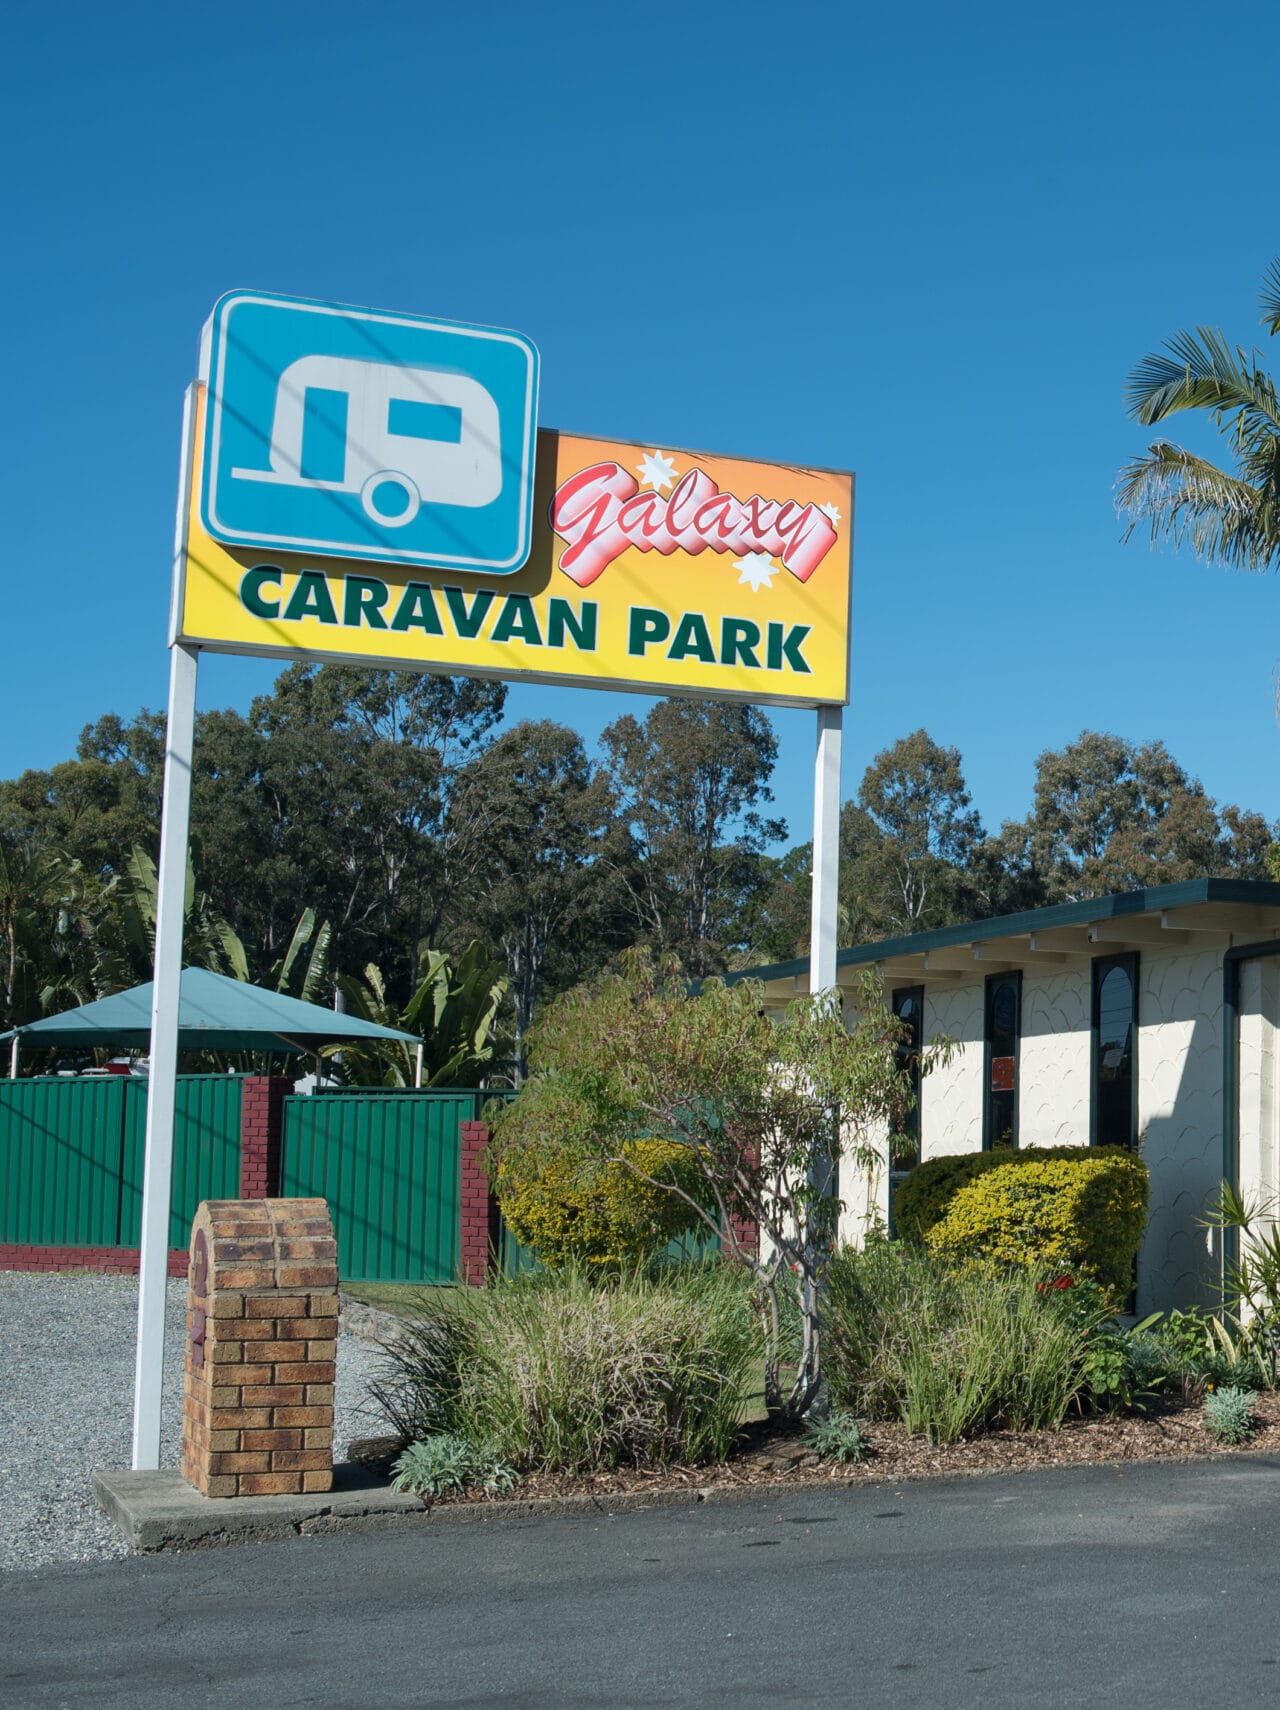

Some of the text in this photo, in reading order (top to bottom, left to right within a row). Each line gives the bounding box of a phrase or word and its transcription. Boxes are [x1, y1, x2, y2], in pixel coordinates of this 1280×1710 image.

[549, 461, 838, 587] Galaxy
[240, 564, 813, 675] CARAVAN PARK
